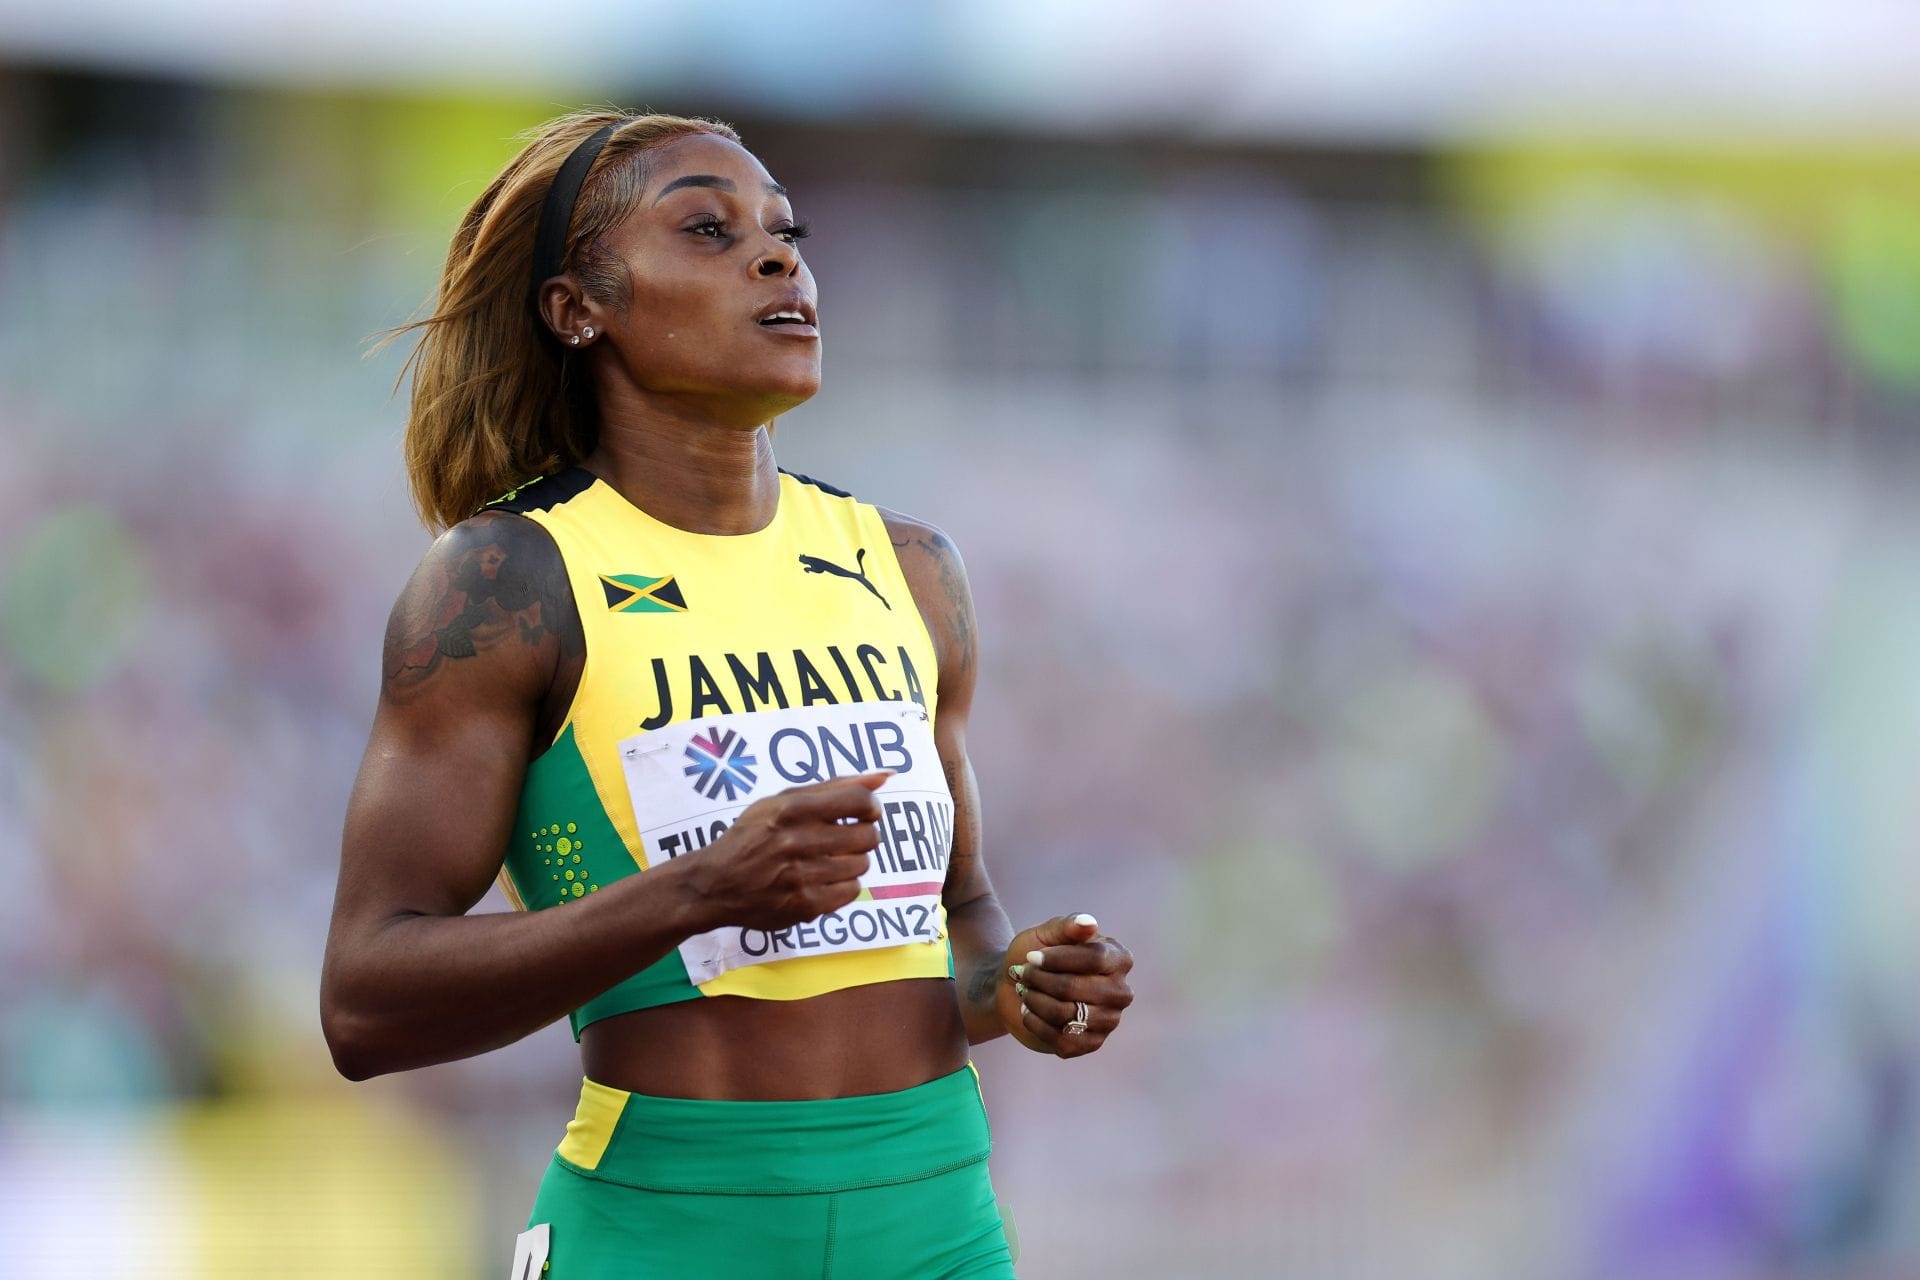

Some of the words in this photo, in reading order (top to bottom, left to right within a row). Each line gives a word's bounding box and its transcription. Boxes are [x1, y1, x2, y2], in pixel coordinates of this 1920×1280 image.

[640, 644, 929, 731] JAMAICA
[769, 720, 913, 784] QNB
[740, 904, 938, 957] OREGON2
